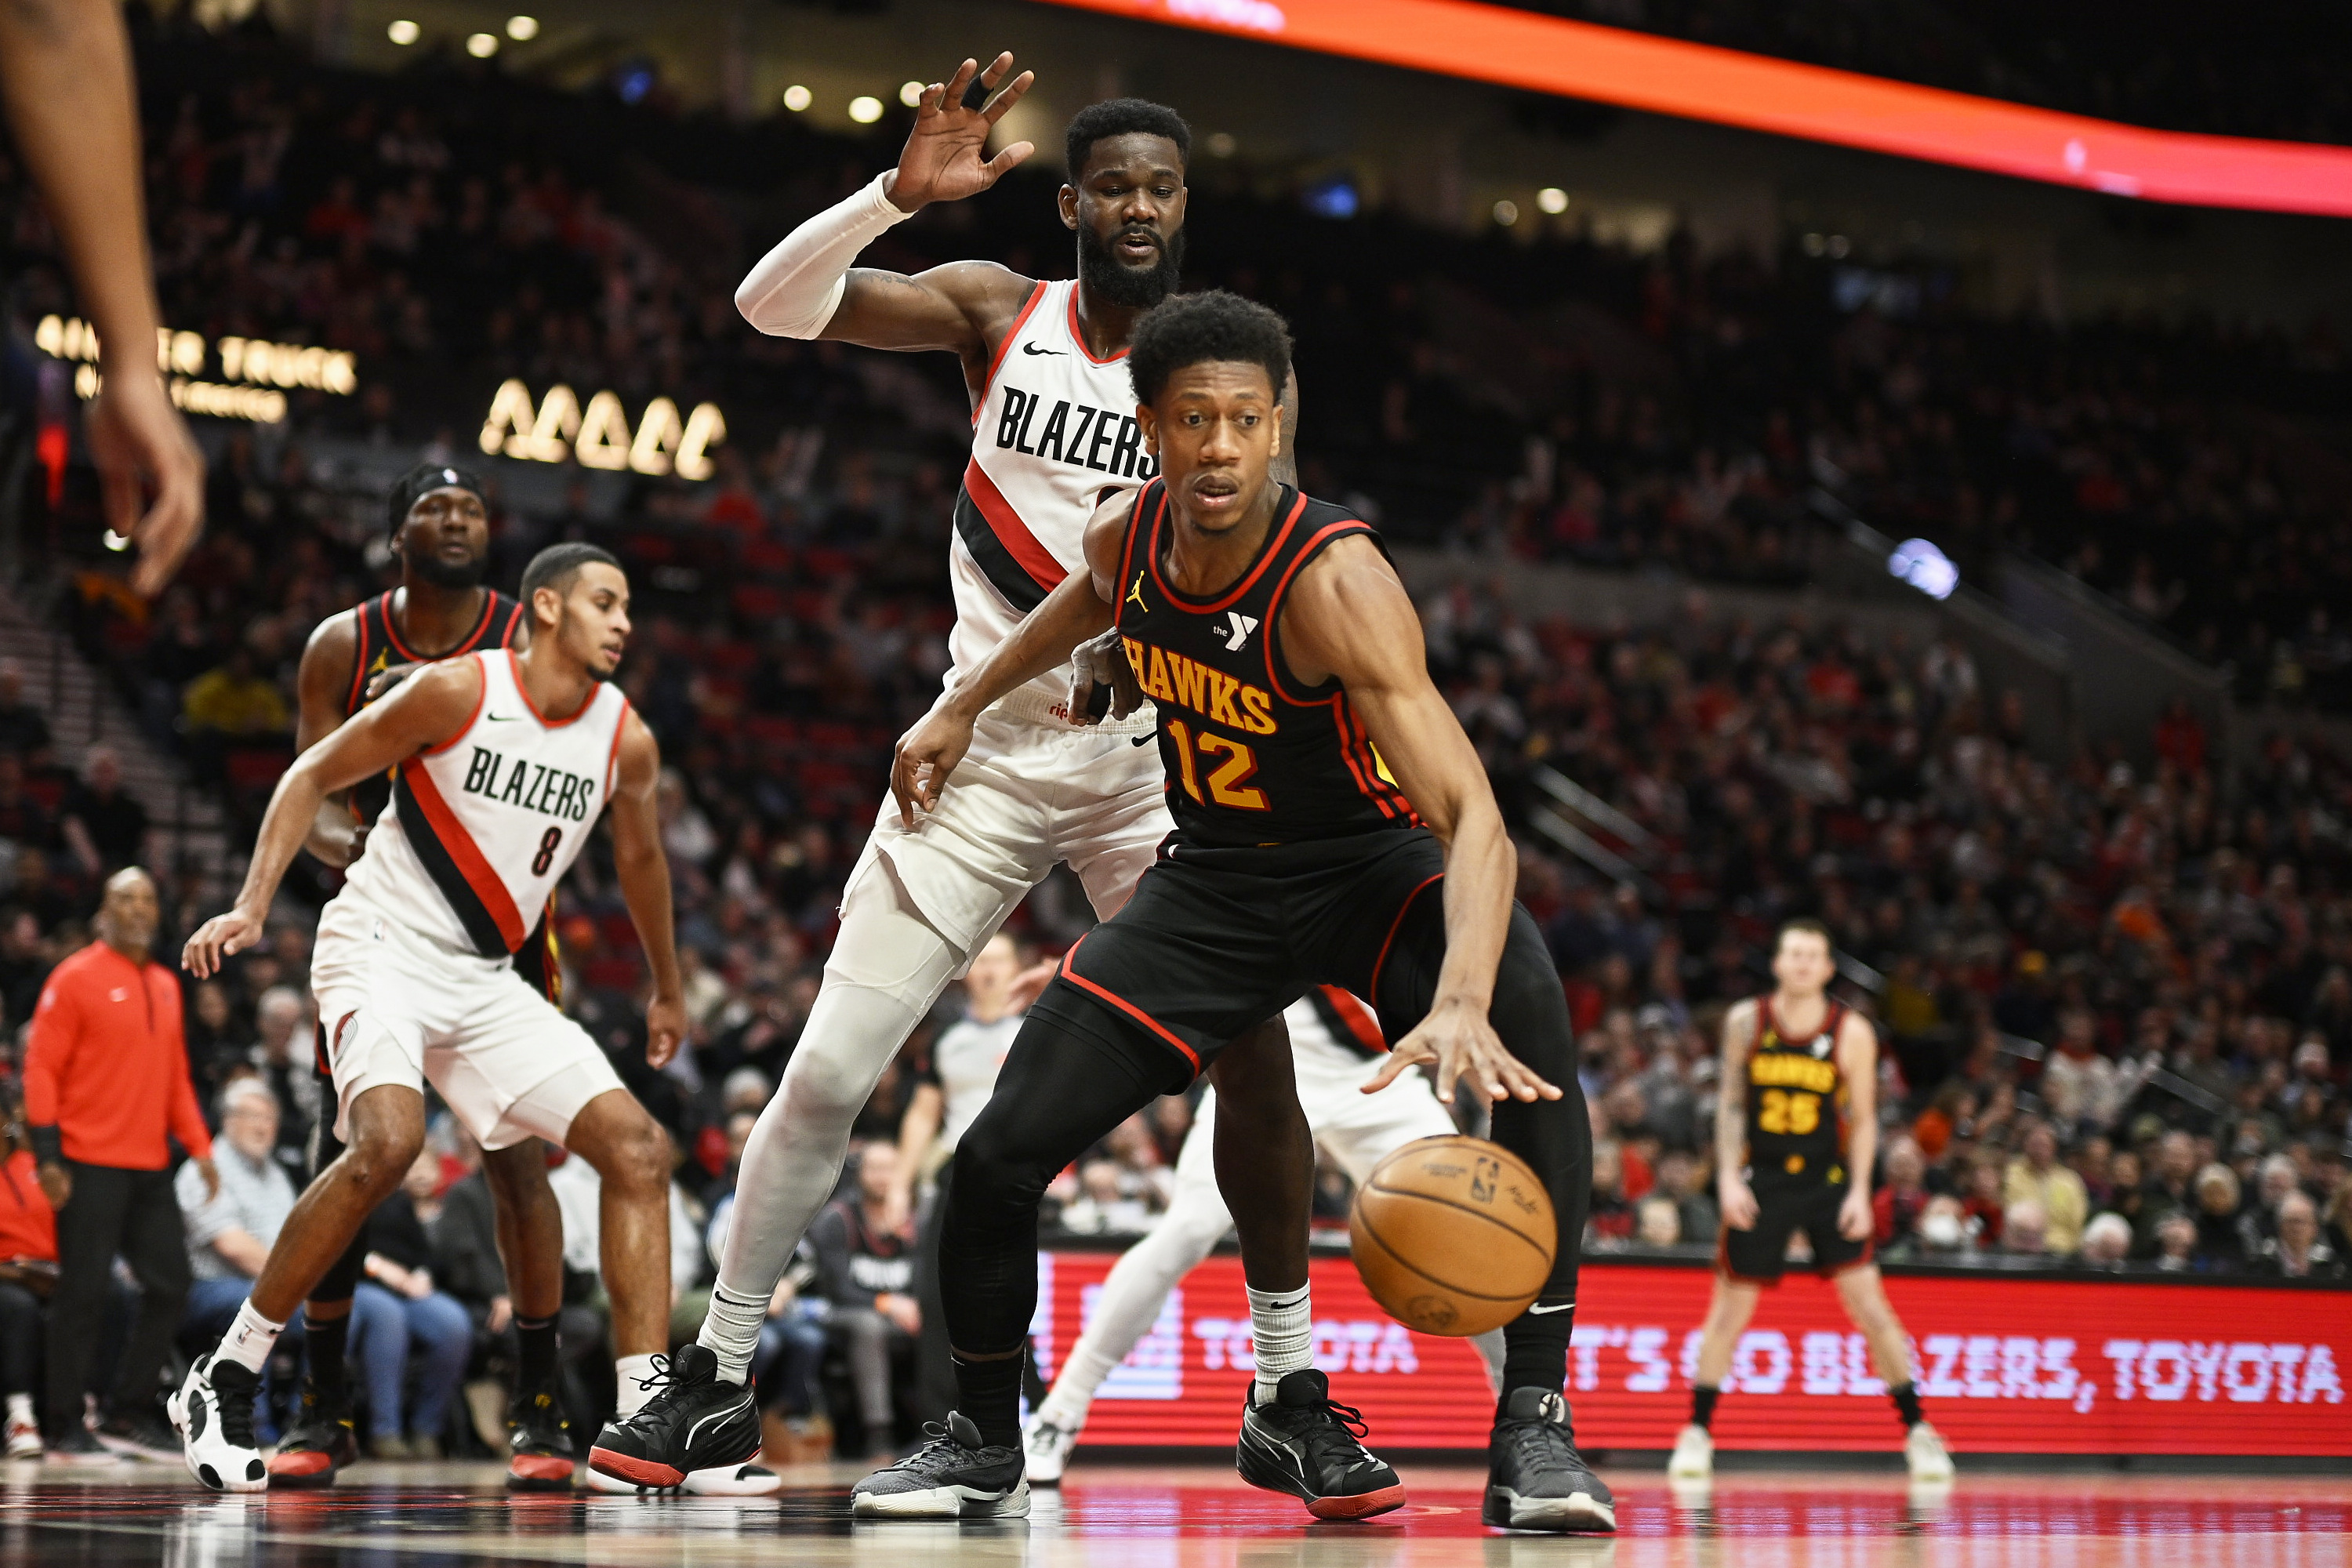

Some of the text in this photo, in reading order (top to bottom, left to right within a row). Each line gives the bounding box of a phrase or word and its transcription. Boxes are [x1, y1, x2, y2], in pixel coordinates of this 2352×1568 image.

[1213, 626, 1228, 637] the
[1121, 633, 1279, 735] HAWKS
[463, 746, 596, 822] BLAZERS
[1166, 717, 1272, 812] 12
[531, 826, 562, 877] 8
[1759, 1089, 1821, 1134] 25
[1192, 1317, 1419, 1373] TOOTA
[1567, 1325, 1671, 1392] T'S
[2102, 1339, 2346, 1404] TOYOTA
